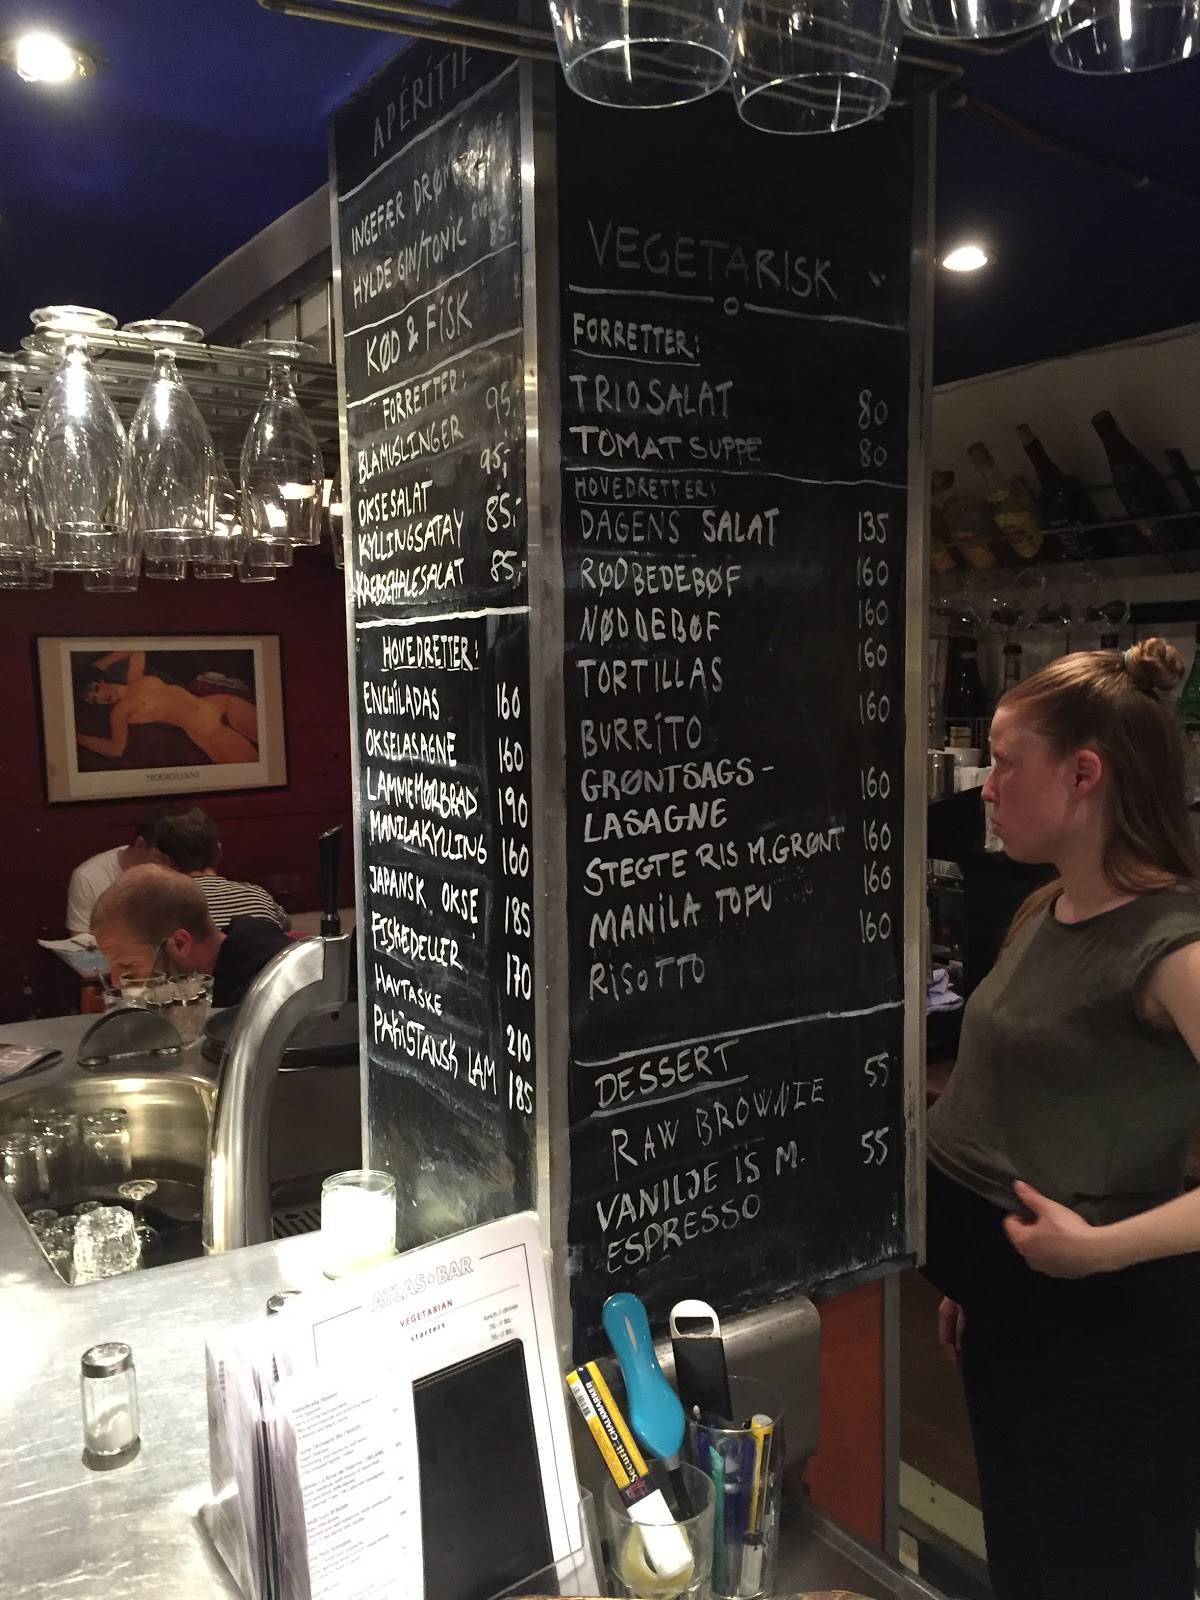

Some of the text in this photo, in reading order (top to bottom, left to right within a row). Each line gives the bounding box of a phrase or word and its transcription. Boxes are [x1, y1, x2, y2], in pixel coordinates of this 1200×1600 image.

[353, 257, 393, 309] HYLDE
[588, 220, 838, 300] VEGETARISK
[366, 291, 473, 377] KØD & FISK
[572, 312, 701, 360] FORRETTER:
[857, 388, 889, 430] 80
[858, 438, 888, 468] 80
[357, 480, 434, 528] OKSESALAT
[580, 507, 890, 548] DAGENS SALAT 135
[856, 556, 890, 588] 160
[579, 598, 890, 647] NØDDEBØF 160
[575, 636, 889, 699] TORTILLAS 160
[363, 678, 522, 721] ENCHILADAS 160
[579, 690, 891, 760] BURRITO 160
[365, 727, 525, 775] OKSELASAGNE 160
[498, 785, 529, 830] 190
[583, 766, 891, 843] LASAGNE 160
[502, 836, 531, 879] 160
[583, 848, 689, 897] STEGTE
[695, 840, 739, 871] RIS
[862, 819, 892, 853] 160
[369, 864, 532, 939] JAPANSK OKSE 185
[588, 860, 892, 950] MANILA TOFU 160
[506, 951, 533, 1001] 170
[588, 908, 892, 1002] RISOTTO 160
[374, 962, 532, 1064] HAVTASKE 210
[468, 1045, 498, 1096] LAM
[508, 1069, 534, 1115] 185
[594, 1038, 891, 1110] DESSERT 55
[610, 1077, 826, 1182] RAW BROWNIE
[596, 1160, 719, 1233] VANILJE
[734, 1151, 762, 1185] IS
[860, 1126, 891, 1167] 55
[606, 1193, 762, 1275] ESPRESSO
[399, 1299, 454, 1328] VEGETARIAN
[410, 1322, 447, 1343] starters
